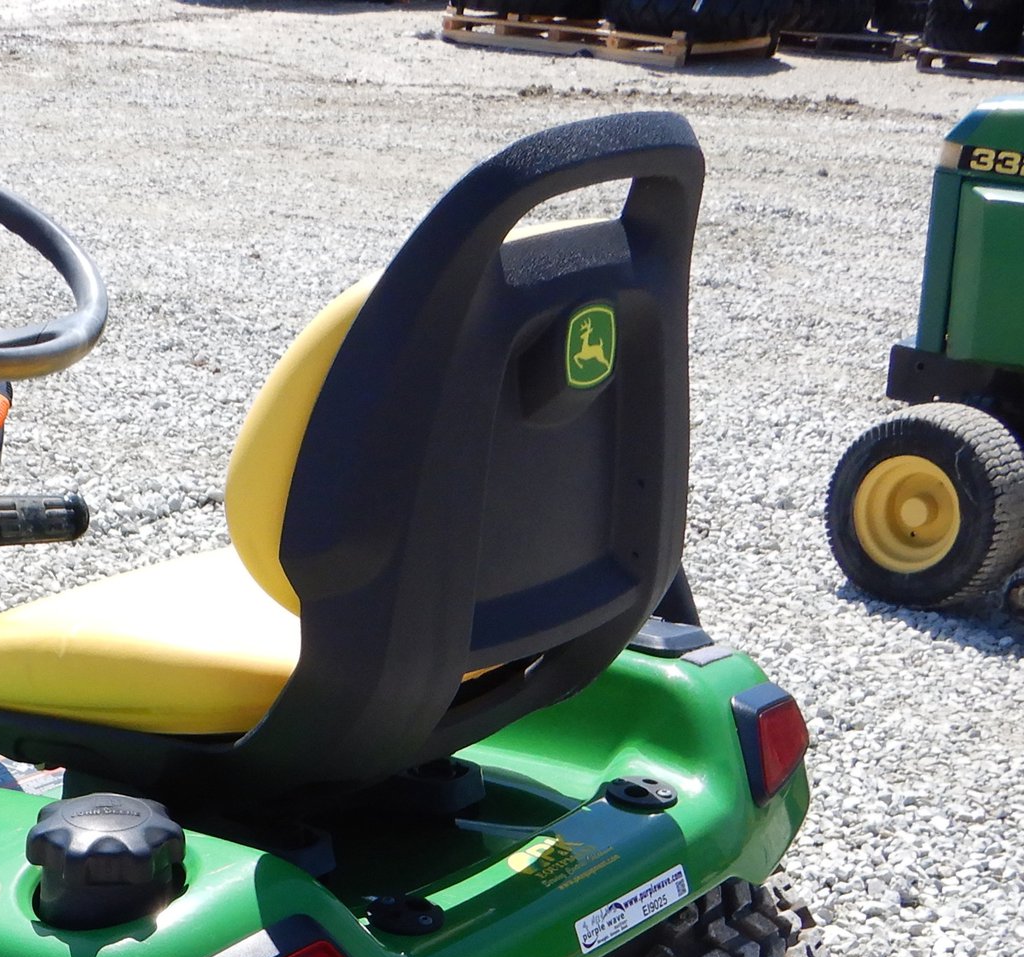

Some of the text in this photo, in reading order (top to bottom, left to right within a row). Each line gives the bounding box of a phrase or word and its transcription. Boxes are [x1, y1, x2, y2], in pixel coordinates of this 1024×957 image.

[969, 147, 1024, 177] 33
[581, 923, 606, 943] purple
[606, 912, 626, 928] wave
